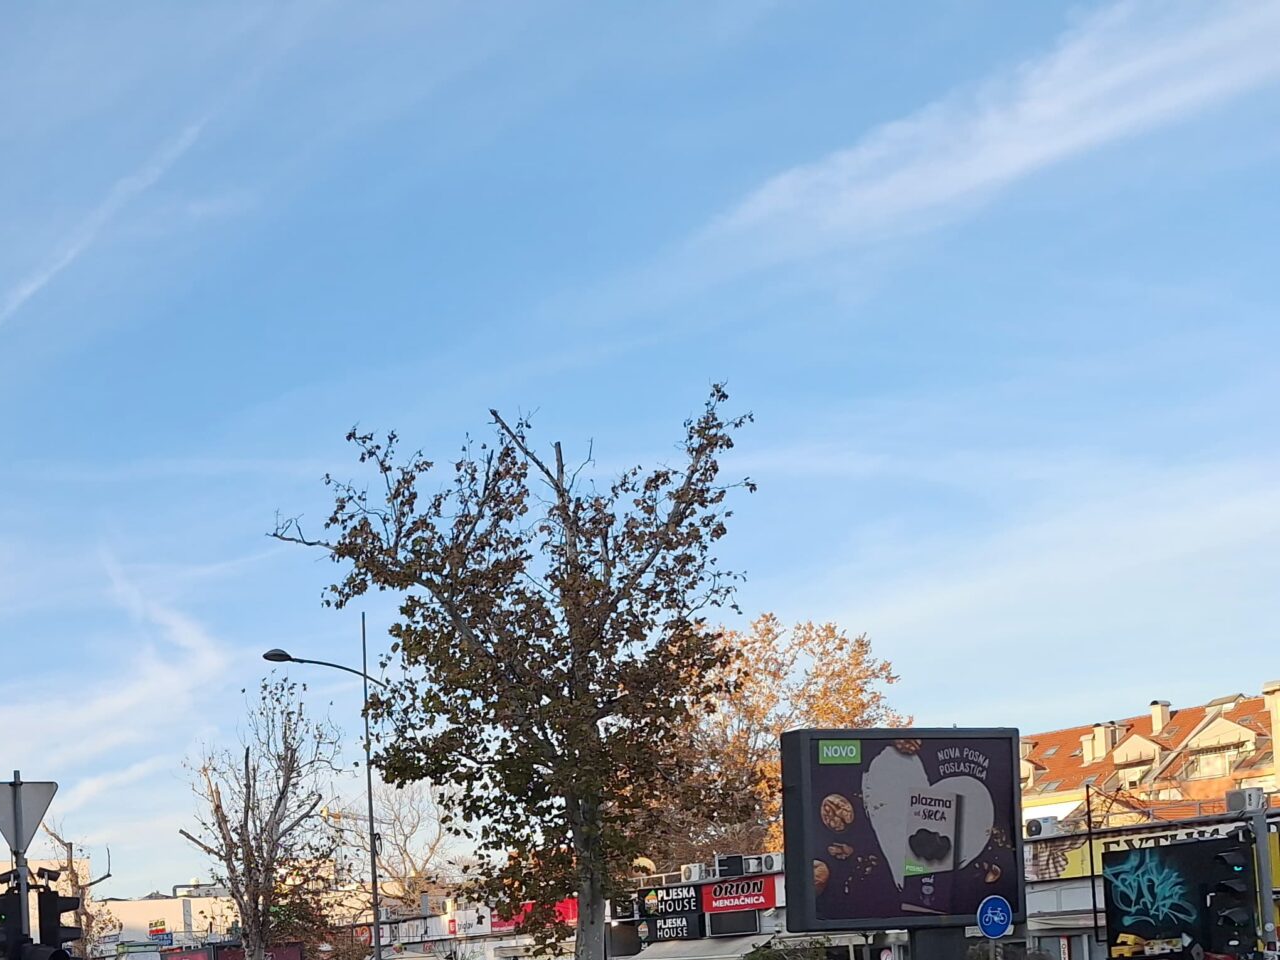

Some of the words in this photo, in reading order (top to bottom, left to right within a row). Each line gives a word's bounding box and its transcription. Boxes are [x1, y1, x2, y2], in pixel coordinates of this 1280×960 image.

[823, 745, 856, 757] NOVO
[937, 747, 960, 761] NOVA
[963, 747, 989, 768] POSNA
[939, 762, 987, 780] POSLASTICA
[910, 793, 952, 809] plazma
[922, 808, 947, 822] SRCA
[657, 886, 696, 900] PLJESKA
[712, 880, 765, 898] ORION
[658, 898, 697, 913] HOUSE
[712, 896, 765, 908] MENJAČNICA
[656, 917, 688, 929] PLJESKA
[656, 927, 688, 938] HOUSE
